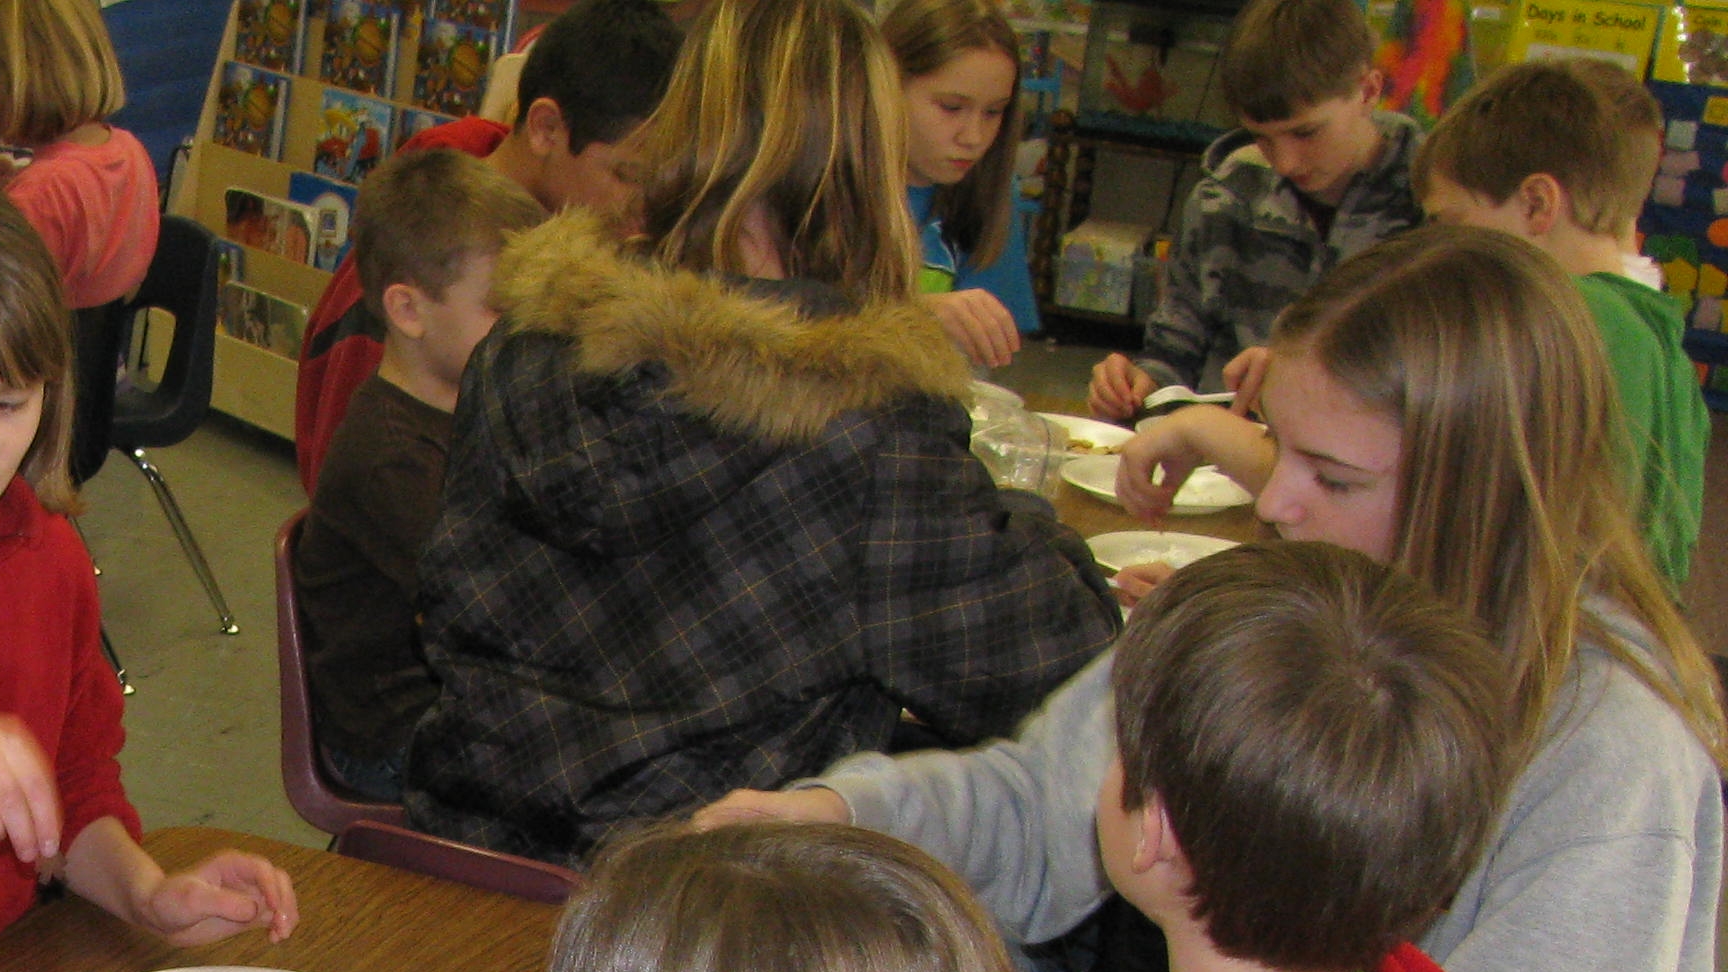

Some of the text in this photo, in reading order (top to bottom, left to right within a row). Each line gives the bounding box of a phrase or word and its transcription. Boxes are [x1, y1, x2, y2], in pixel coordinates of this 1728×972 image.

[1527, 3, 1647, 31] Days in School
